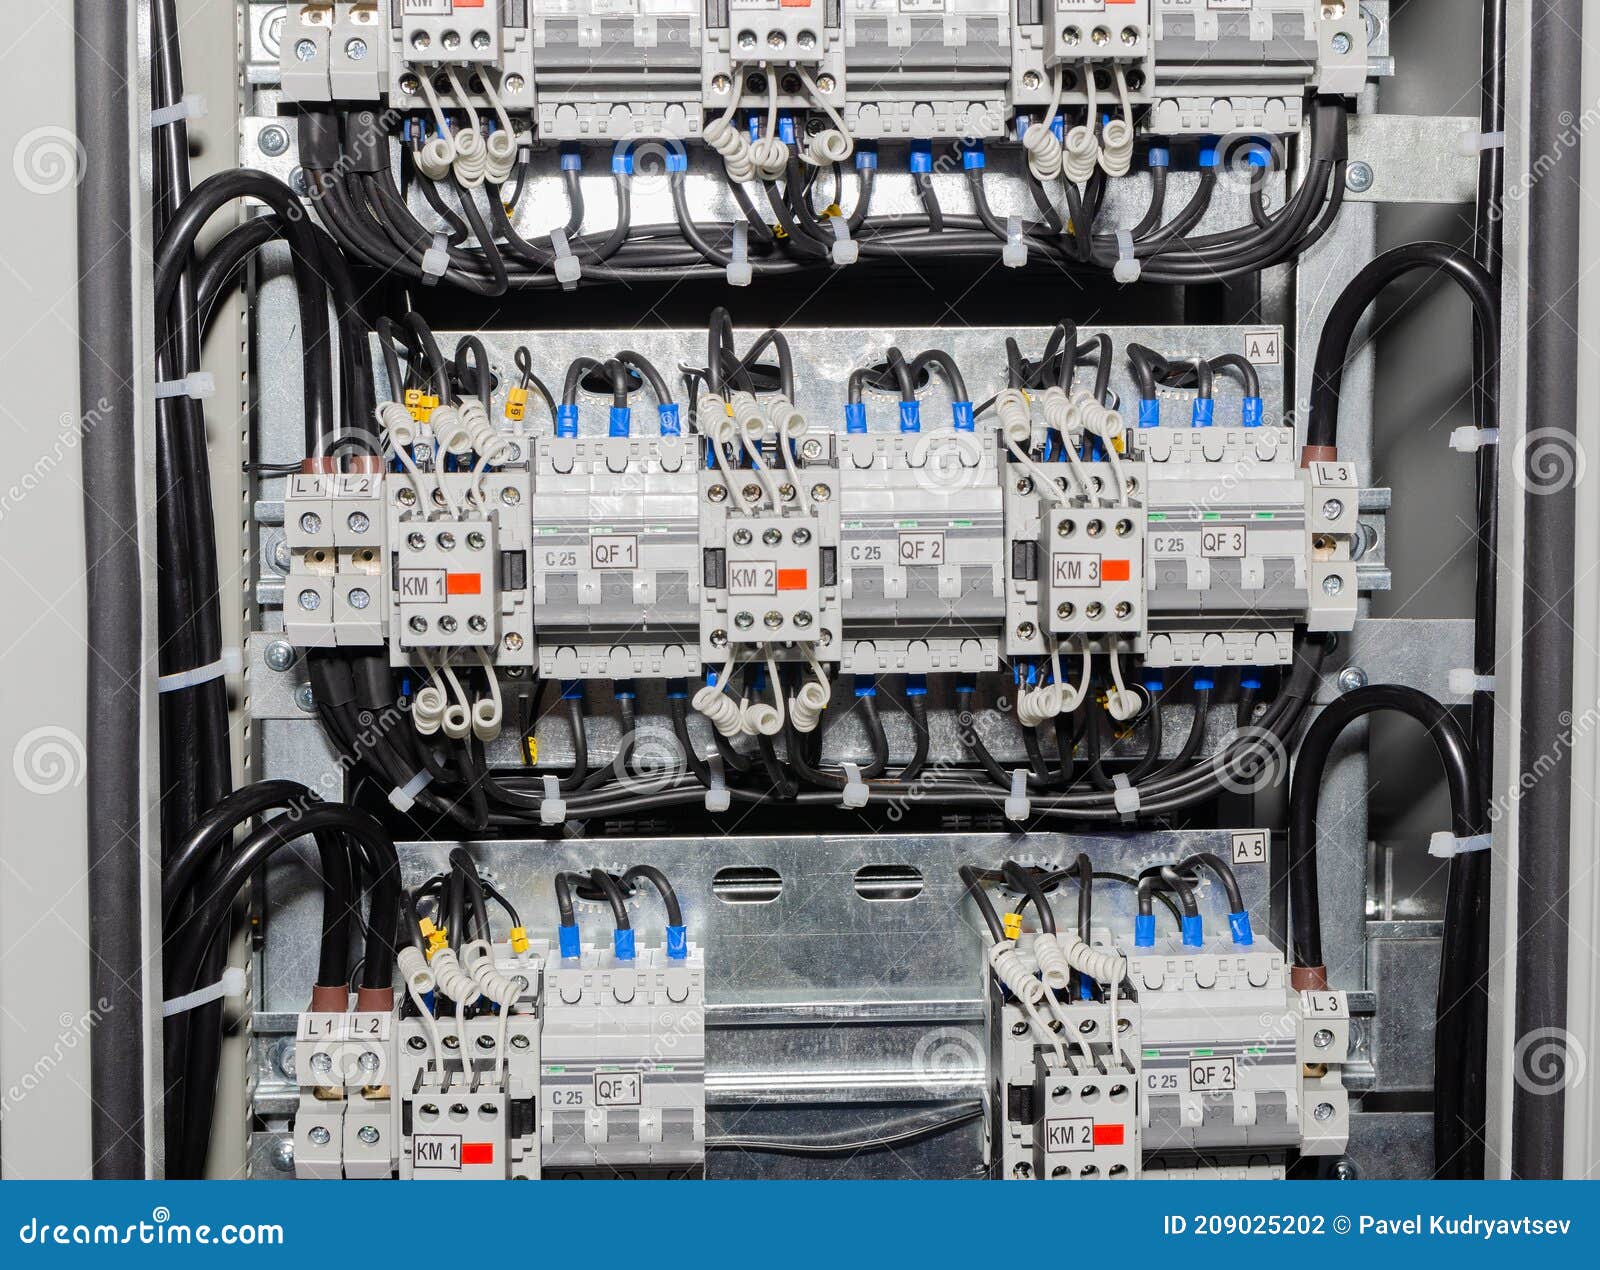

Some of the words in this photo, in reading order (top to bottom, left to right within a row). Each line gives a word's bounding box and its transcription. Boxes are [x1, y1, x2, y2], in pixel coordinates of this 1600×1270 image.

[1250, 341, 1260, 357] A
[1266, 341, 1275, 357] 4
[1322, 467, 1333, 481] L
[1338, 467, 1347, 480] 3
[297, 479, 307, 492] L
[313, 479, 320, 492] 1
[344, 479, 353, 492] L
[359, 478, 369, 492] 2
[1154, 538, 1163, 552] C
[1168, 538, 1184, 552] 25
[1203, 533, 1226, 553] QF
[1233, 532, 1242, 551] 3
[546, 552, 555, 566] C
[560, 552, 576, 566] 25
[596, 545, 619, 563] QF
[626, 545, 633, 562] 1
[851, 546, 860, 560] C
[865, 546, 881, 560] 25
[902, 541, 924, 561] QF
[932, 541, 940, 558] 2
[732, 569, 756, 587] KM
[765, 569, 774, 587] 2
[1056, 561, 1081, 580] KM
[1089, 561, 1098, 580] 3
[403, 577, 427, 595] KM
[436, 577, 443, 595] 1
[1237, 841, 1248, 857] A
[1254, 840, 1262, 856] 5
[1313, 996, 1325, 1011] L
[1329, 995, 1338, 1011] 3
[309, 1020, 318, 1035] L
[325, 1019, 332, 1035] 1
[355, 1018, 363, 1033] L
[370, 1018, 380, 1033] 2
[1148, 1075, 1157, 1089] C
[1161, 1075, 1177, 1089] 25
[1193, 1066, 1215, 1085] QF
[1223, 1066, 1231, 1083] 2
[599, 1081, 622, 1099] QF
[629, 1080, 636, 1097] 1
[553, 1091, 562, 1105] C
[567, 1091, 583, 1105] 25
[1050, 1126, 1074, 1145] KM
[1082, 1126, 1091, 1144] 2
[417, 1142, 442, 1161] KM
[450, 1142, 457, 1160] 1
